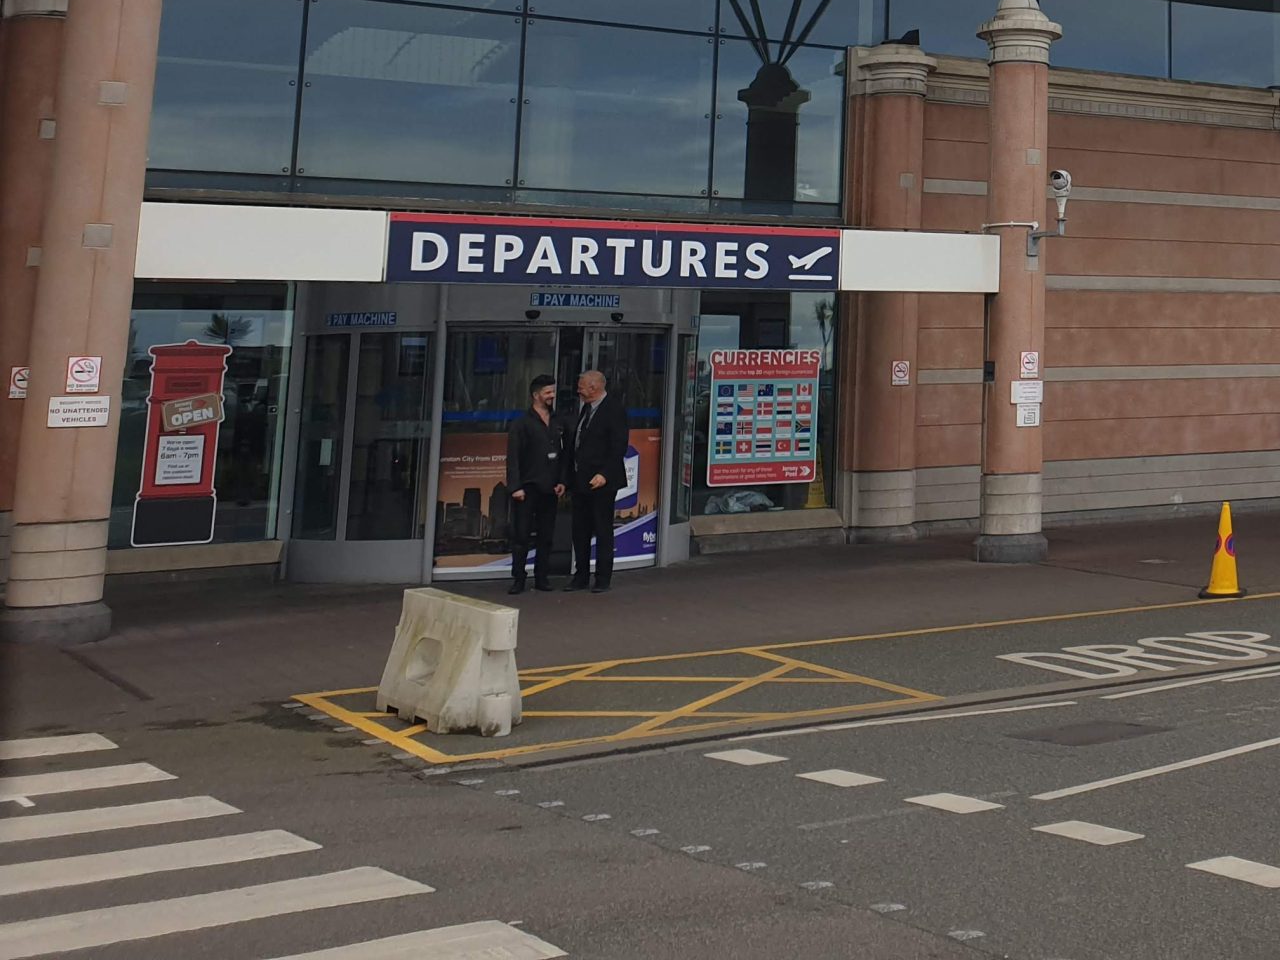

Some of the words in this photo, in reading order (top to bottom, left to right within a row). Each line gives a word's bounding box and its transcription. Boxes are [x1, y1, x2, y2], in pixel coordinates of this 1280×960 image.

[410, 231, 770, 278] DEPARTURES
[543, 294, 566, 307] PAY
[570, 294, 620, 308] MACHINE
[332, 313, 349, 326] PAY
[351, 312, 397, 326] MACHINE
[711, 350, 820, 366] CURRENCIES
[171, 407, 214, 427] OPEN
[160, 452, 178, 460] 6am
[183, 452, 200, 460] 7pm
[462, 455, 475, 463] City
